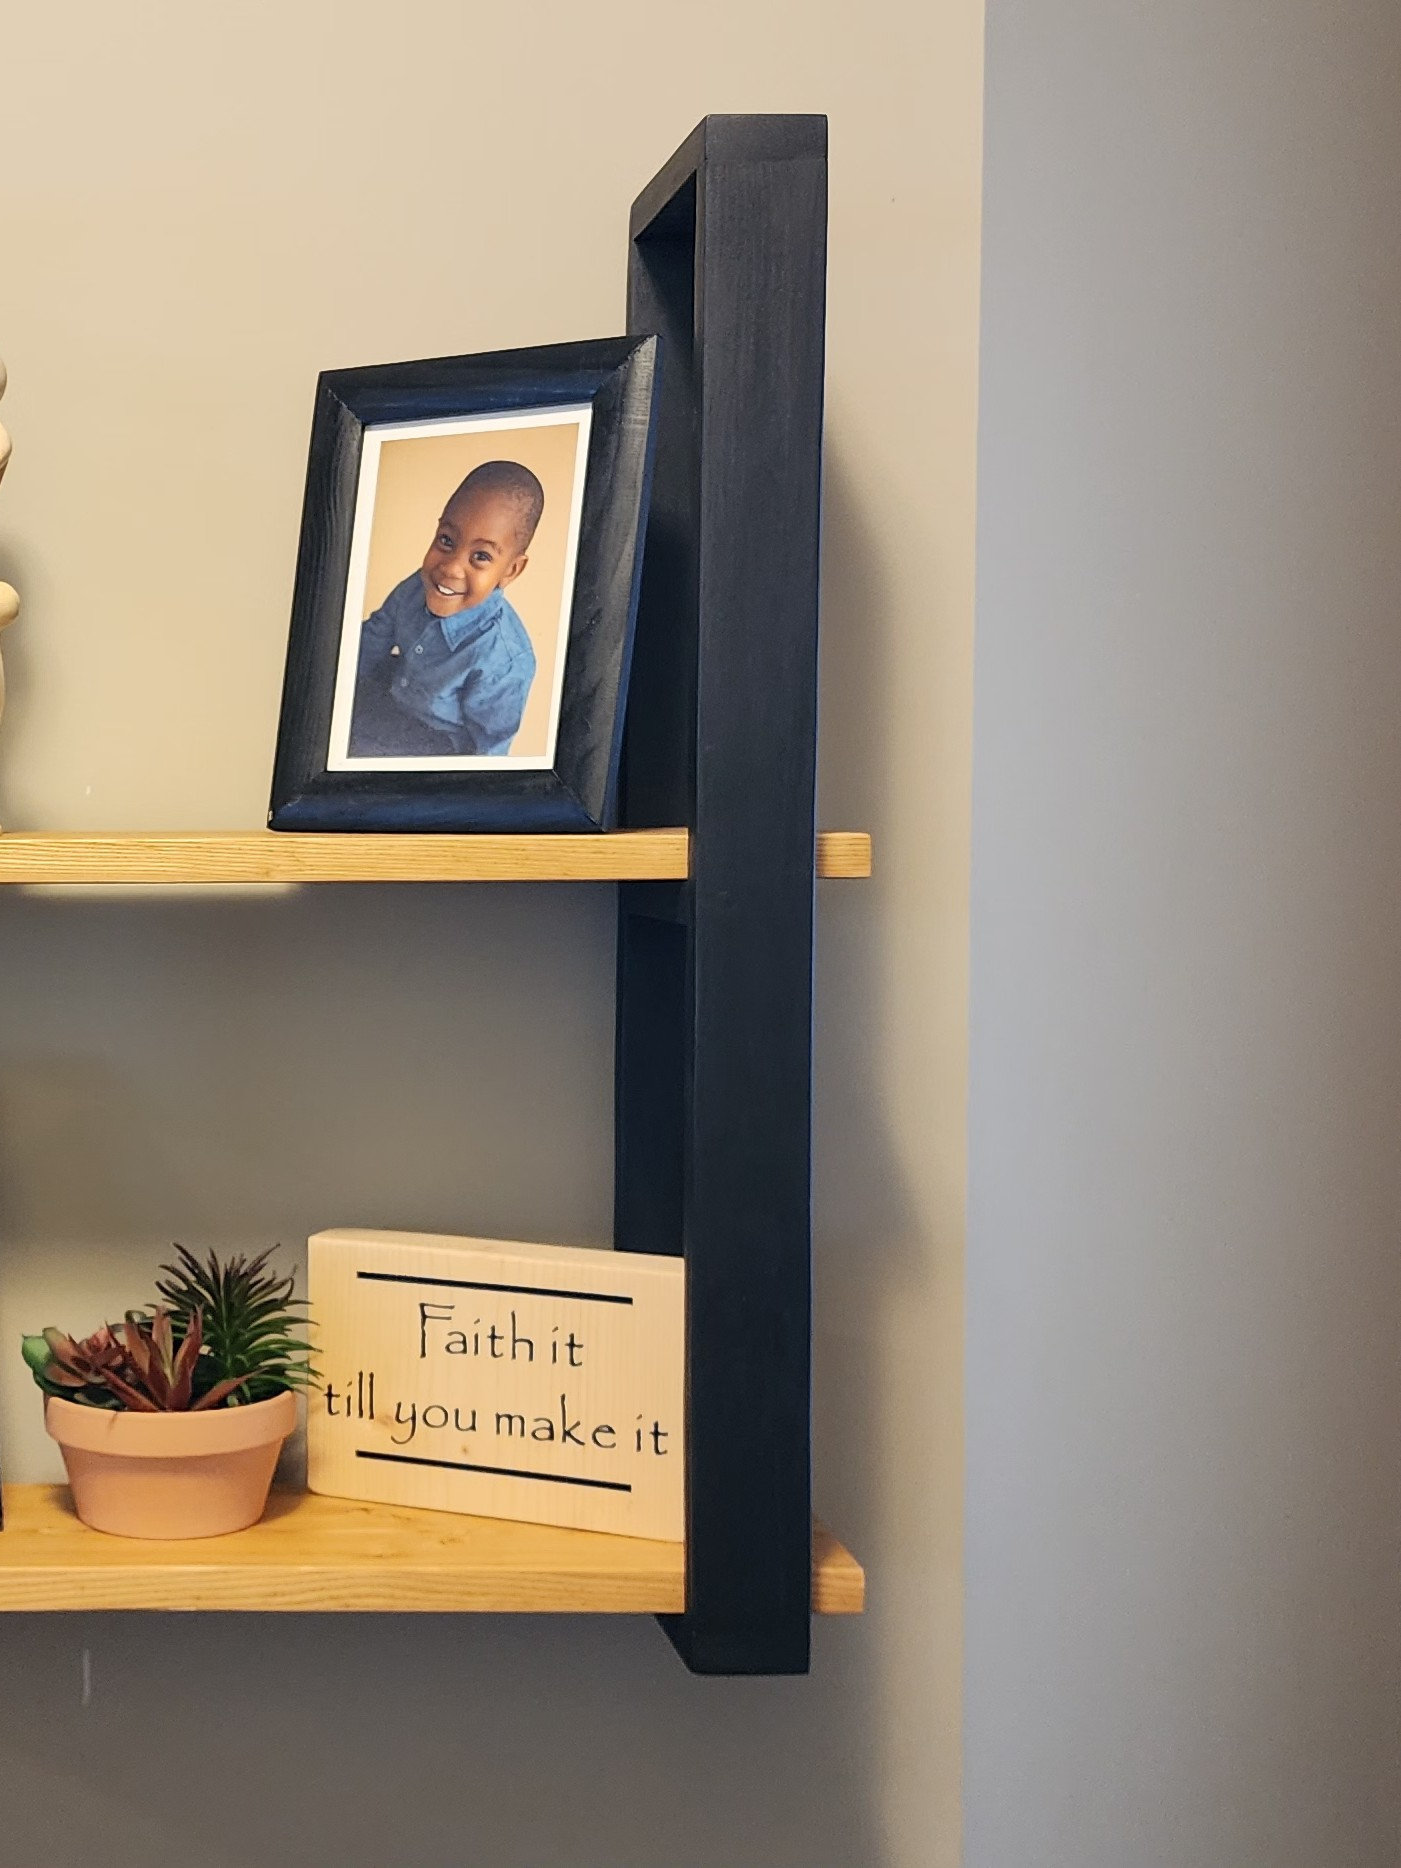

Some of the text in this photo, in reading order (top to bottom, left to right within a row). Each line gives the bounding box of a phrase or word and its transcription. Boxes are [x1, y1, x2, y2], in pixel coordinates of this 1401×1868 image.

[418, 1302, 585, 1367] Faith it
[323, 1371, 669, 1456] till you make it
